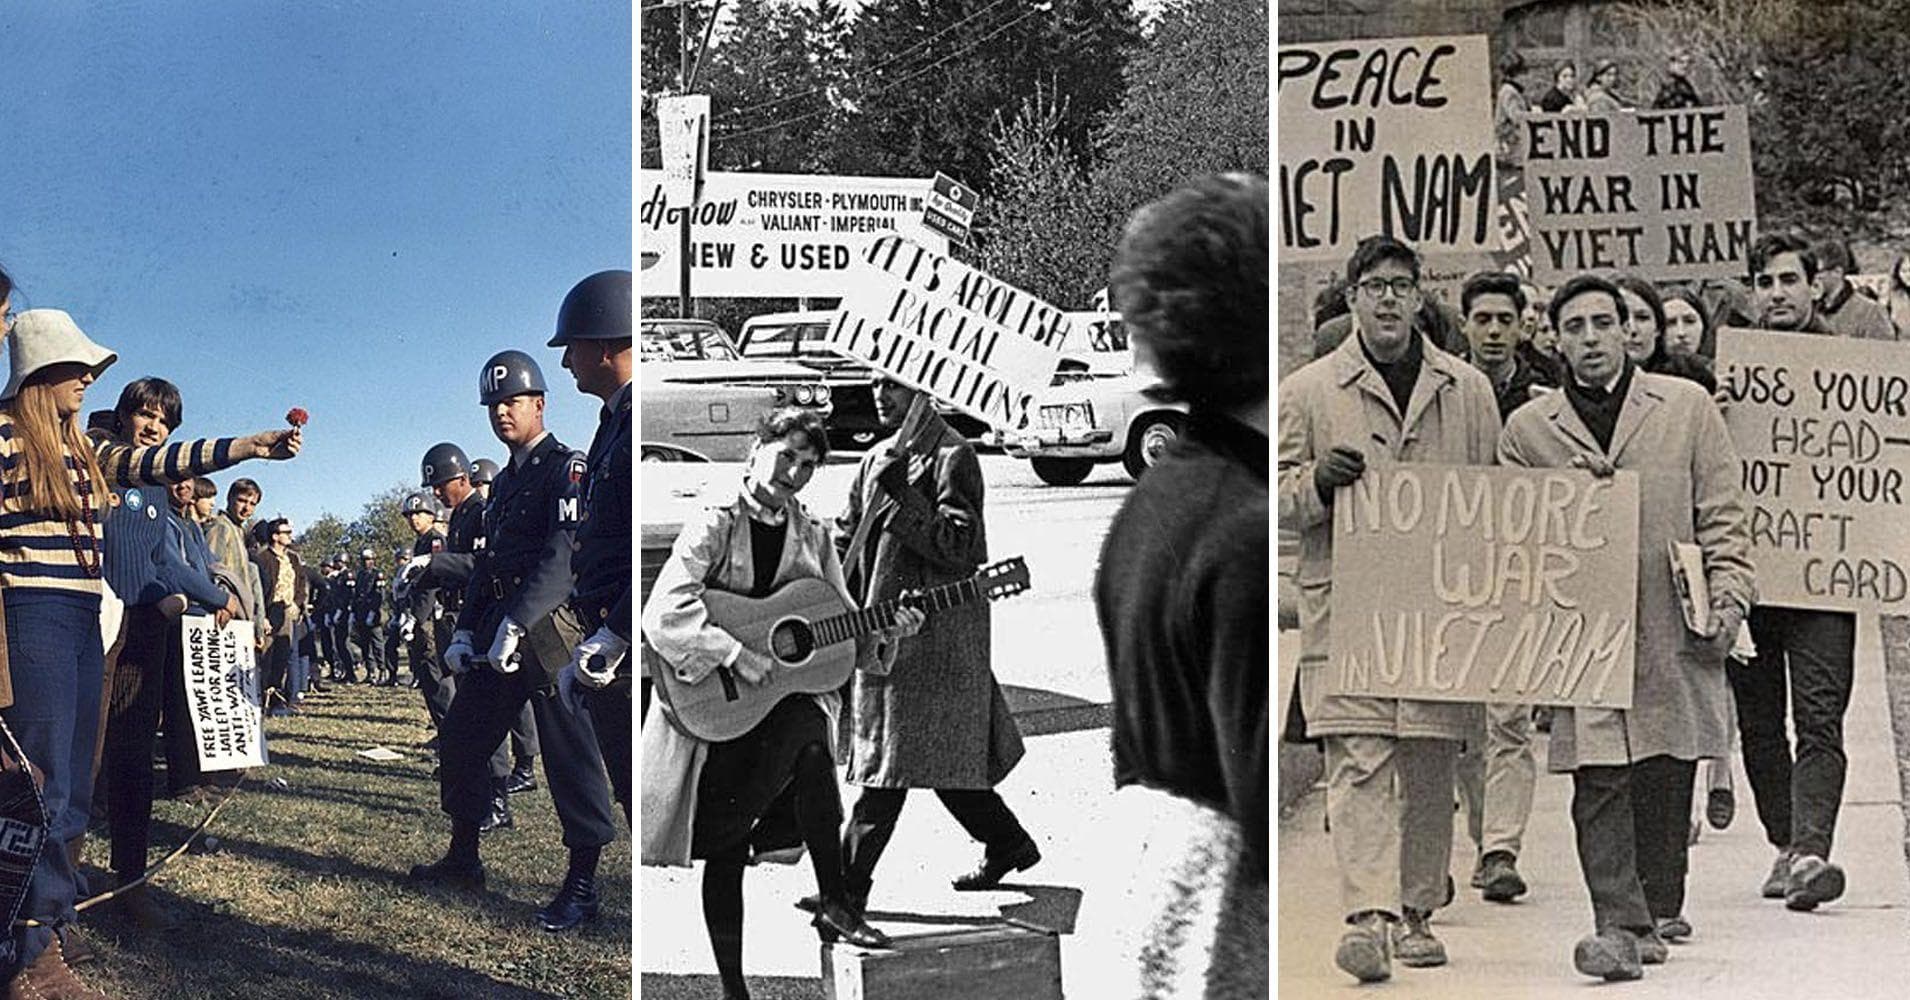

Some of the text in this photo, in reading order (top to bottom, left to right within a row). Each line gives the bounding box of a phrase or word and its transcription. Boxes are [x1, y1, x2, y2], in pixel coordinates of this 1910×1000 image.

[1279, 45, 1455, 109] PEACE
[1334, 116, 1375, 152] IN
[1527, 111, 1726, 160] END THE
[747, 189, 823, 210] CHRYSLER
[832, 193, 907, 212] PLYMOUTH
[1279, 158, 1355, 248] IET
[1382, 153, 1492, 248] NAM
[1538, 172, 1701, 215] WAR IN
[760, 213, 897, 233] VALIANT IMPERIAL
[1540, 226, 1644, 270] VIET
[1667, 219, 1752, 266] NAM
[750, 243, 769, 270] &
[781, 243, 851, 271] USED
[887, 288, 1001, 370] RACIAL
[950, 270, 1072, 352] ABOLISH
[482, 365, 508, 392] MP
[1729, 365, 1908, 417] USE YOUR
[1811, 465, 1903, 505] YOUR
[1344, 469, 1613, 552] NO MORE
[1750, 505, 1854, 552] RAFT
[1432, 541, 1580, 610] WAR
[1804, 557, 1908, 603] CARD
[189, 627, 206, 684] LEADERS
[1339, 610, 1631, 704] IN VIET NAM
[206, 628, 233, 757] JAILED FOR AIDING
[201, 726, 217, 759] FREE
